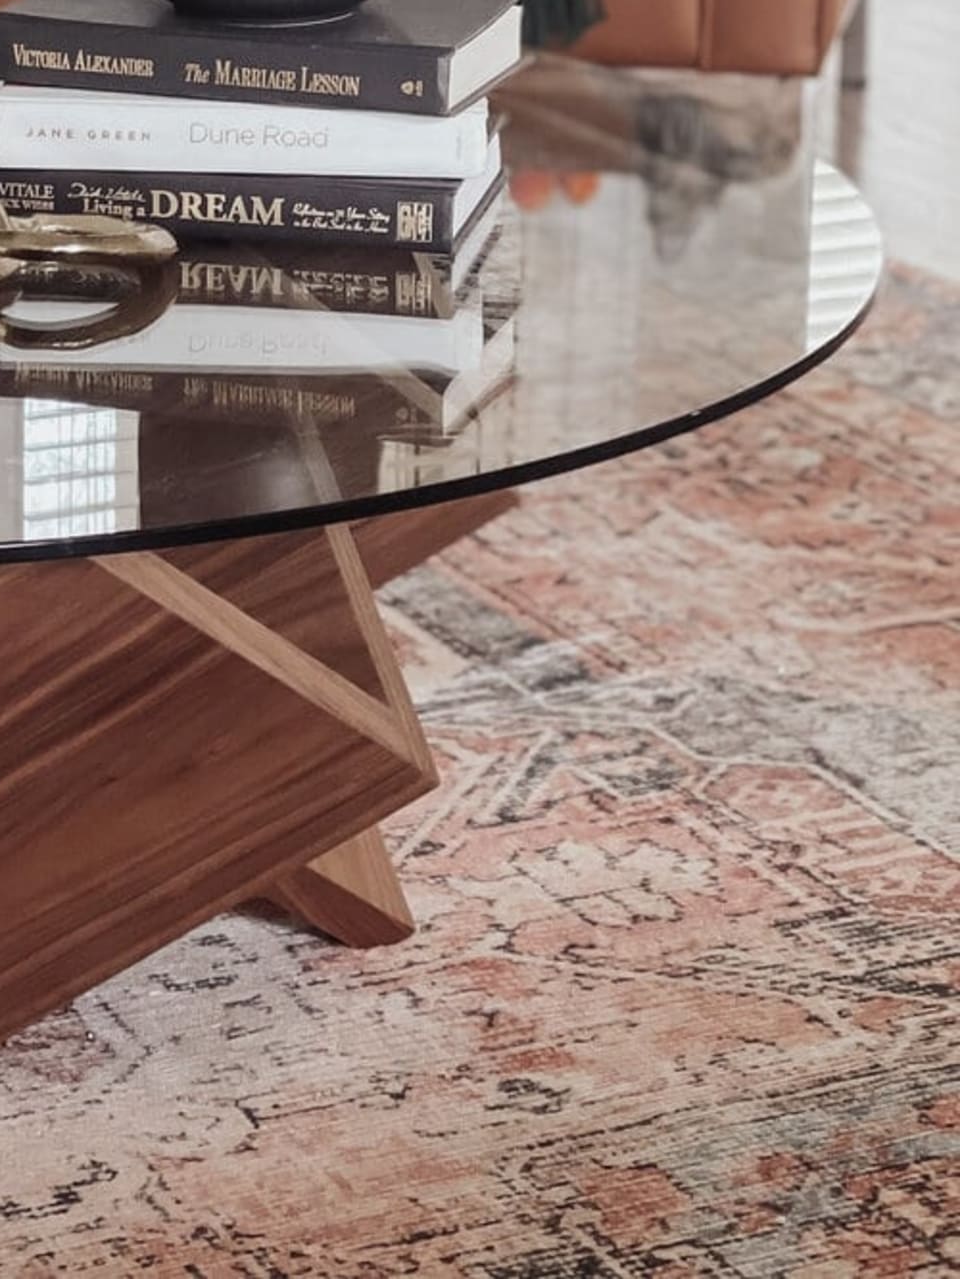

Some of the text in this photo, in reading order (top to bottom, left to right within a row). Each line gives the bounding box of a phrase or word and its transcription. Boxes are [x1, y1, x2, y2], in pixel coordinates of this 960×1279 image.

[13, 43, 155, 77] VICTORIA ALEXANDER
[184, 59, 360, 97] The MARRIAGE LESSON
[25, 127, 152, 141] JANE GREEN
[189, 123, 330, 149] Dune Road
[82, 198, 147, 221] Living a
[150, 190, 285, 227] DREAM
